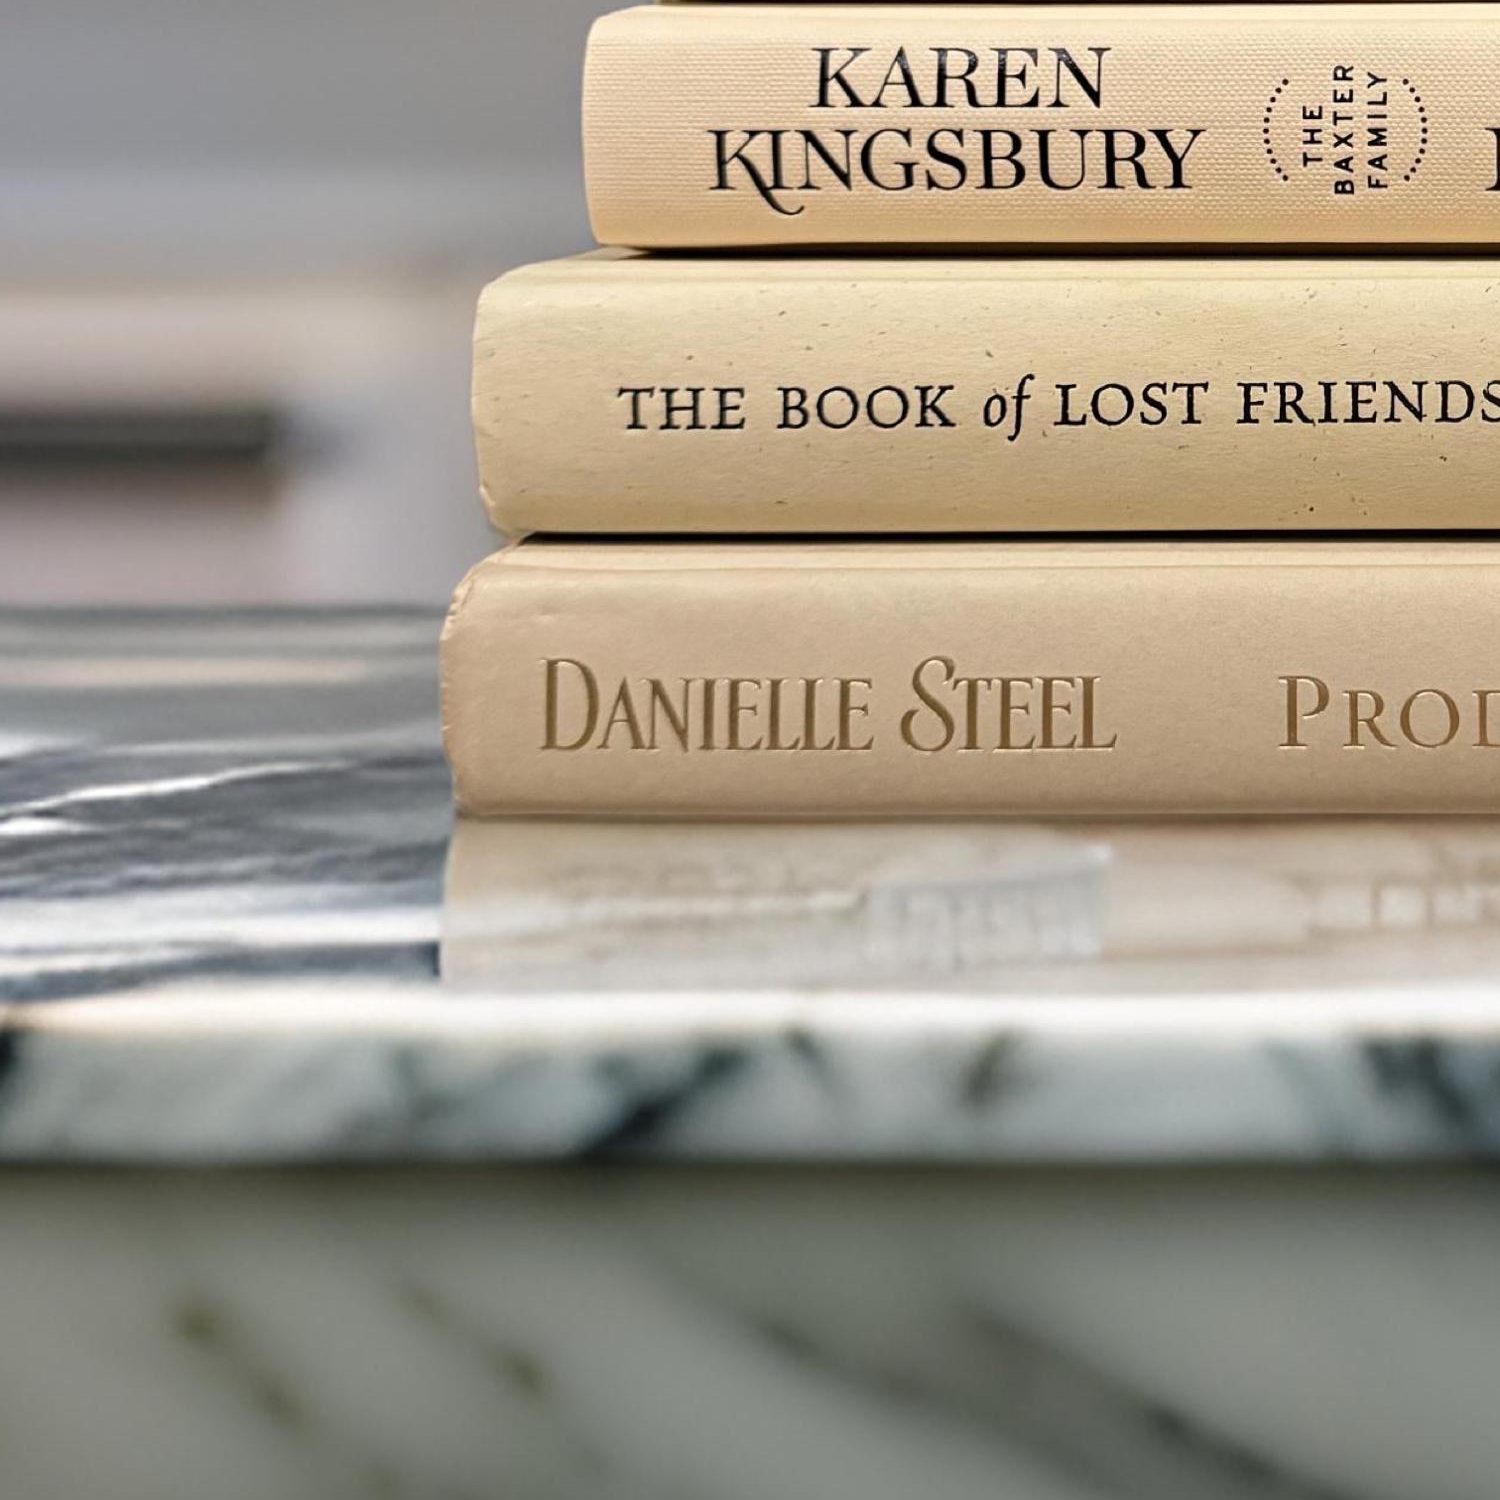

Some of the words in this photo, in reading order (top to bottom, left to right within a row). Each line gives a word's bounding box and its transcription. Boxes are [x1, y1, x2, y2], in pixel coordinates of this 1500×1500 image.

[807, 46, 1112, 109] KAREN
[706, 127, 1207, 216] KINGSBURY
[1301, 104, 1324, 168] THE
[1332, 64, 1355, 196] BAXTER
[1366, 71, 1389, 189] FAMILY
[616, 385, 746, 431] THE
[775, 384, 957, 430] BOOK
[982, 373, 1036, 442] of
[1053, 380, 1210, 427] LOST
[539, 657, 875, 753] DANIELLE
[899, 655, 1118, 753] STEEL
